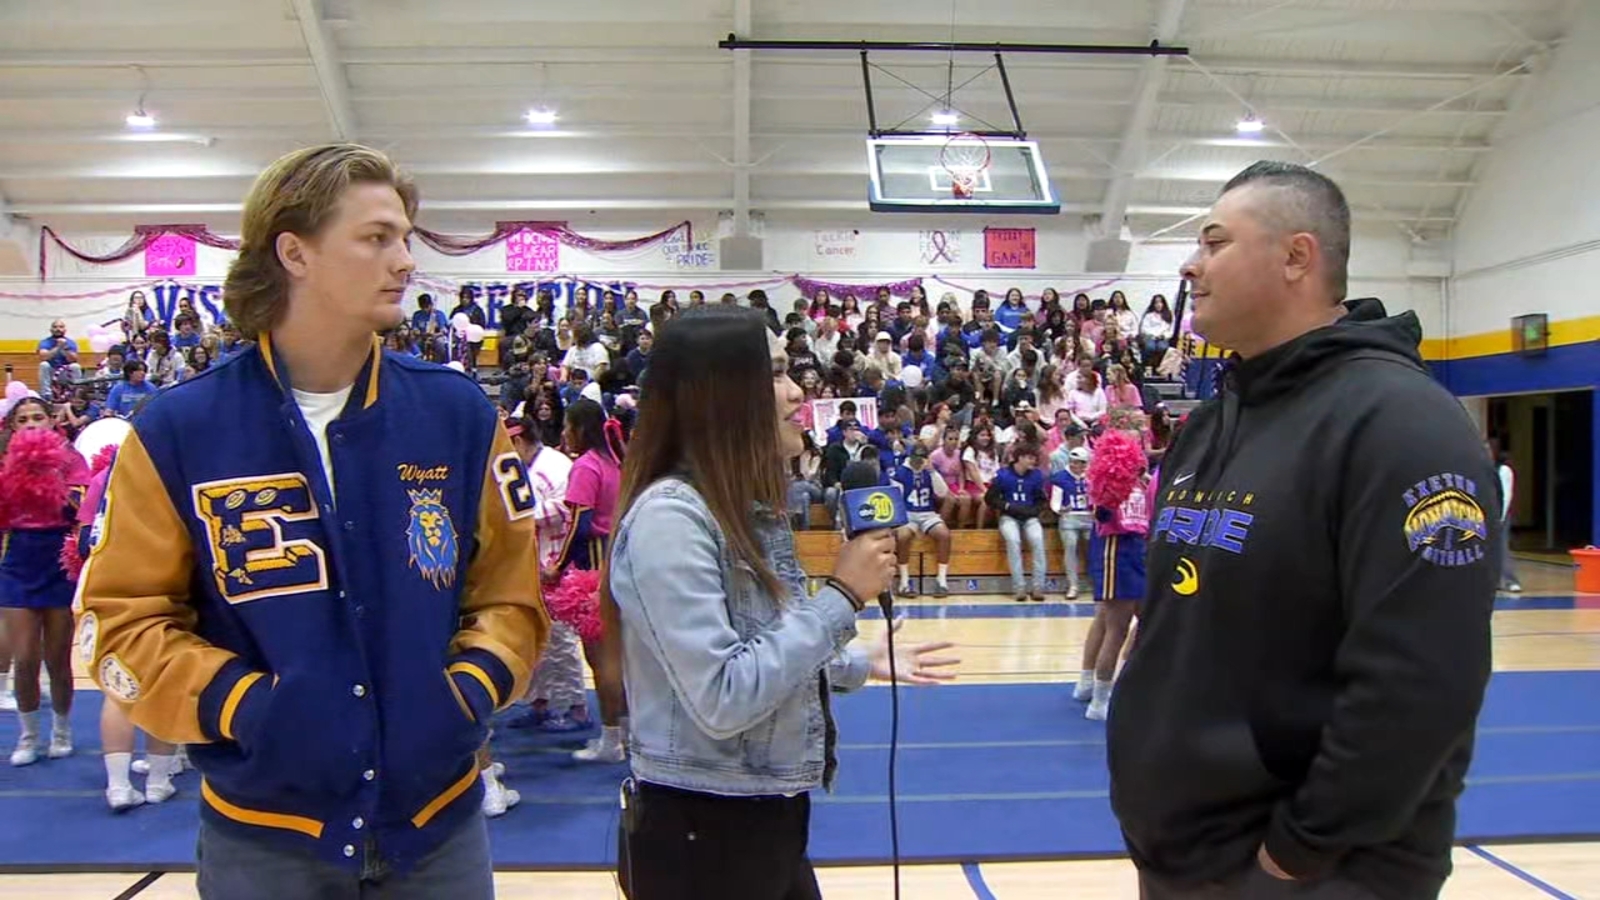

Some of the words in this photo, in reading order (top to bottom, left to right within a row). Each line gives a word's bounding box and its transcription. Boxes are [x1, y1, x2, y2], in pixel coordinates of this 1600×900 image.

[815, 244, 855, 256] Cancer
[397, 463, 450, 485] Wyatt
[906, 487, 931, 507] 42
[192, 471, 329, 605] E
